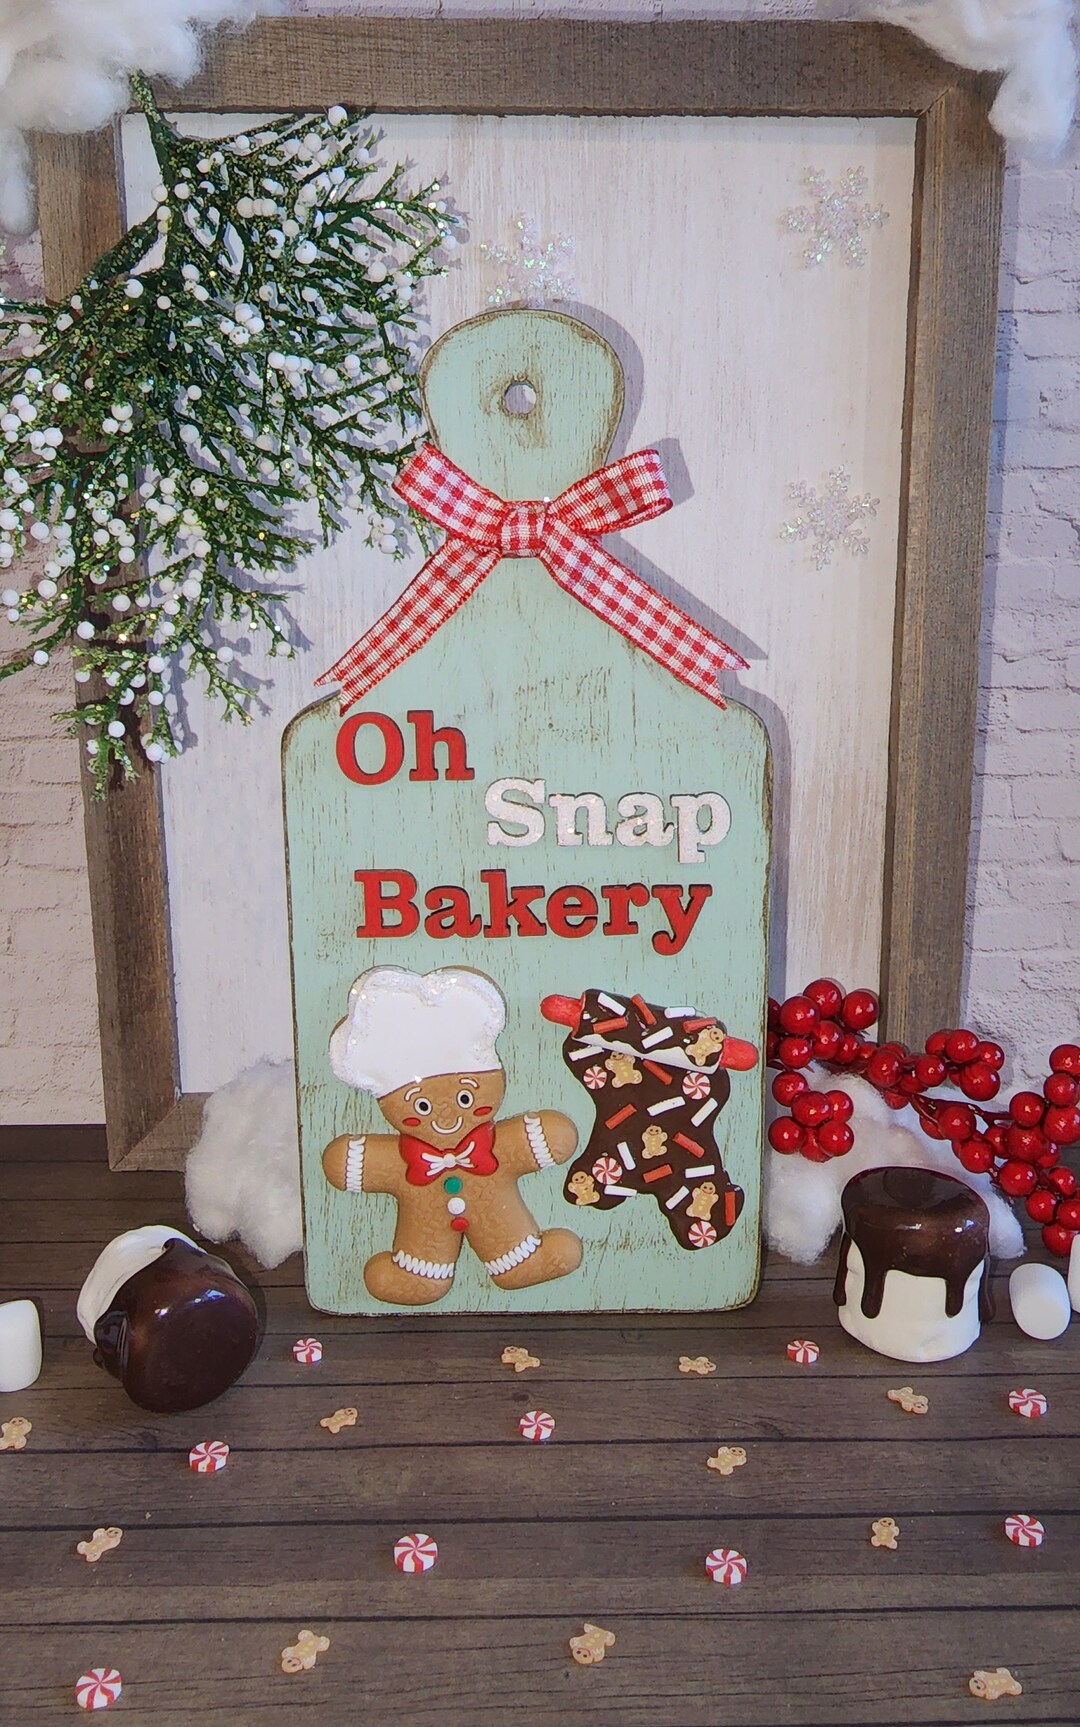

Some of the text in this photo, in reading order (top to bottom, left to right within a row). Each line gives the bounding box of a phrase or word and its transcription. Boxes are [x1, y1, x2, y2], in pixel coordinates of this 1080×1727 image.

[335, 709, 475, 786] Oh
[484, 777, 733, 864] Snap
[354, 869, 713, 957] Bakery
